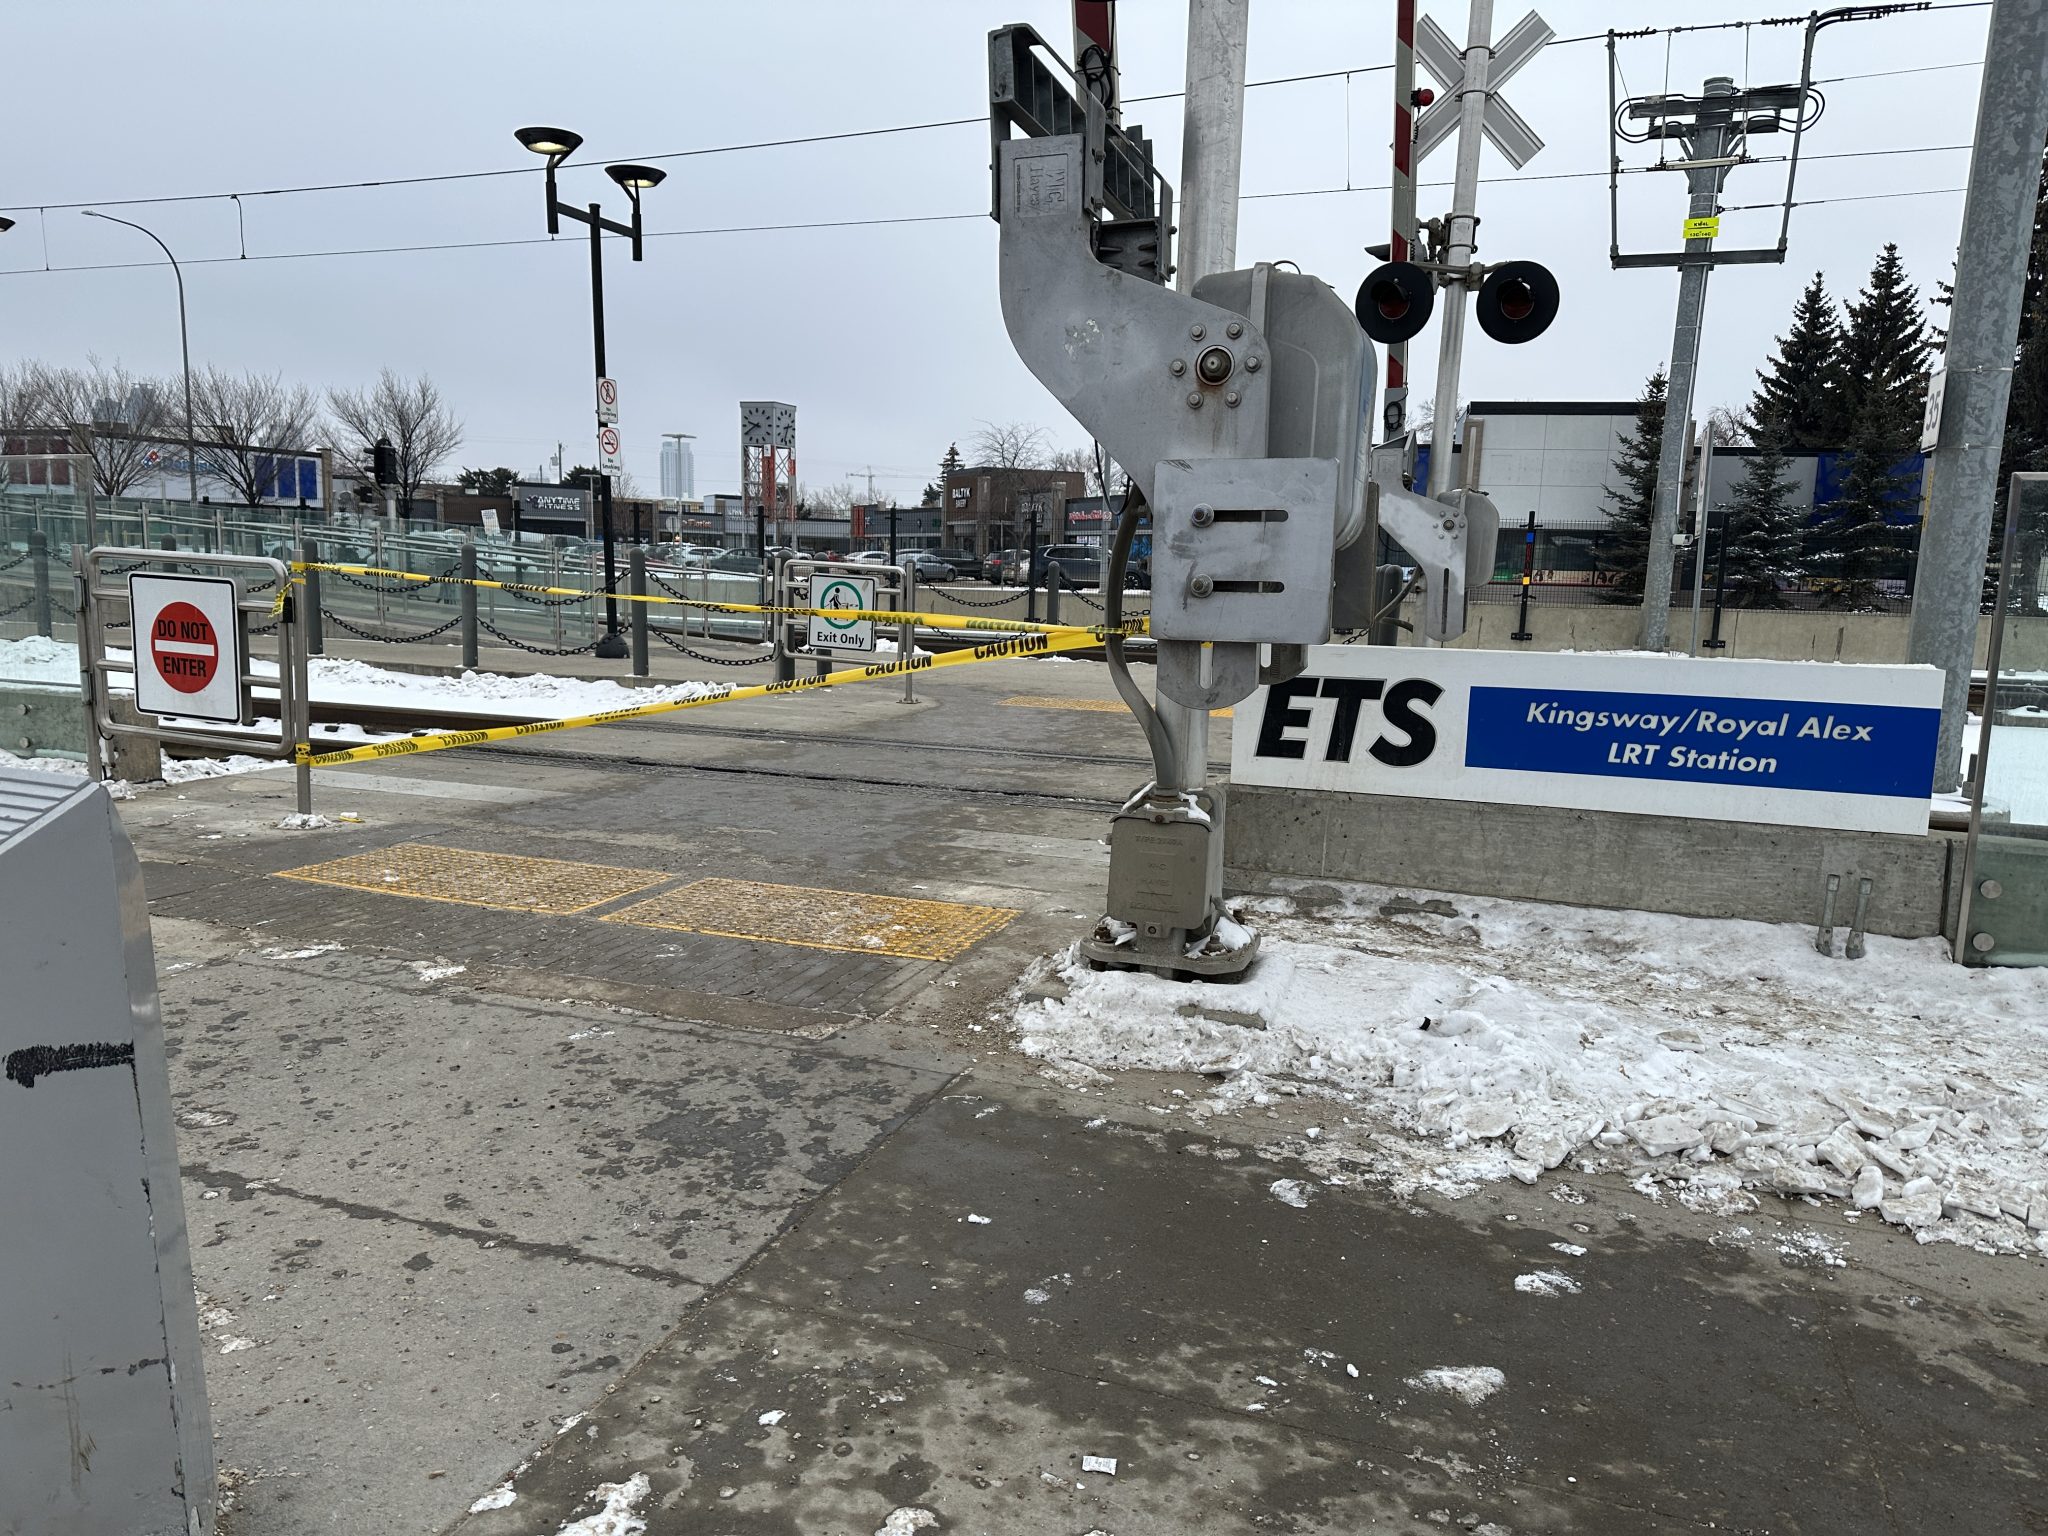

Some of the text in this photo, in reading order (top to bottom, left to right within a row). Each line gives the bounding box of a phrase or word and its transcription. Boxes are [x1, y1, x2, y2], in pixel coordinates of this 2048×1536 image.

[1926, 390, 1941, 431] 35
[537, 496, 580, 504] ANYTIME
[157, 619, 209, 641] DO NOT
[817, 632, 865, 647] Exit Only
[974, 634, 1048, 660] CAUTION
[163, 655, 207, 678] ENTER
[865, 656, 932, 677] CAUTION
[1254, 675, 1446, 768] ETS
[1526, 702, 1875, 742] Kingsway/Royal Alex
[1607, 742, 1778, 774] LRT Station
